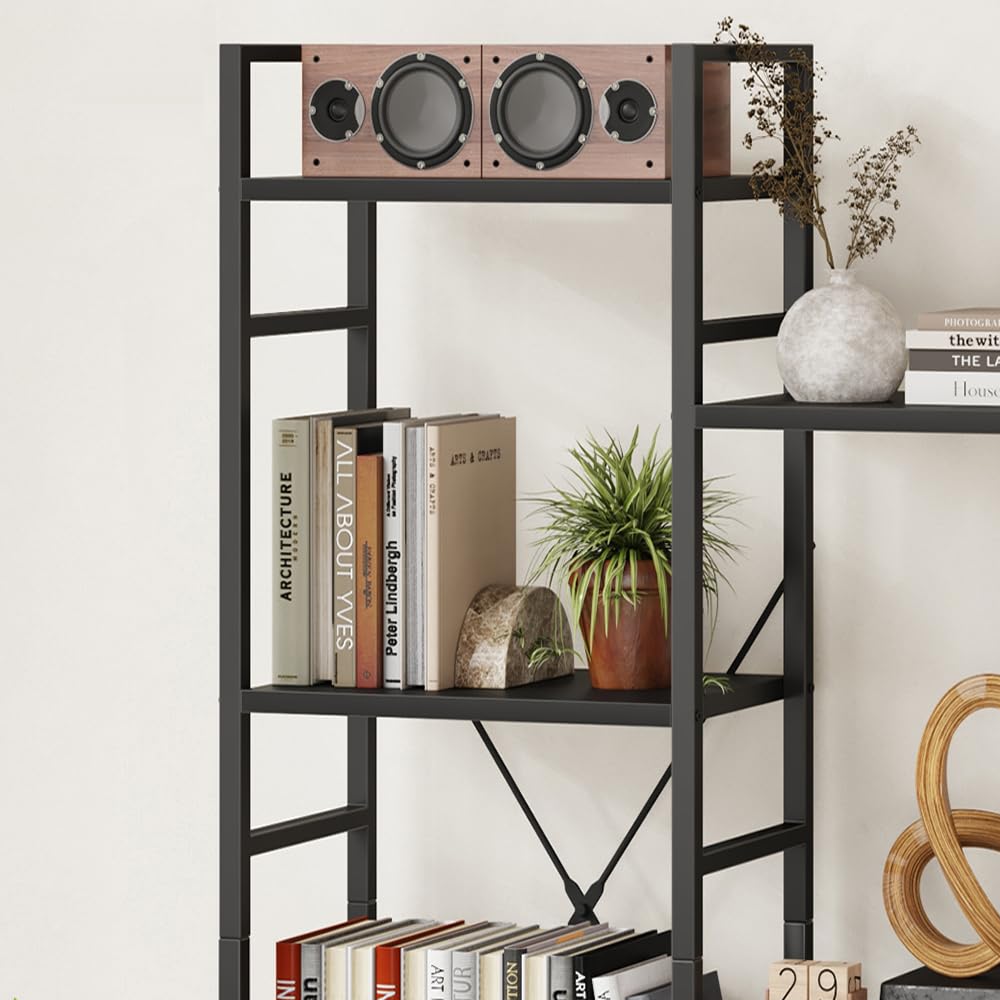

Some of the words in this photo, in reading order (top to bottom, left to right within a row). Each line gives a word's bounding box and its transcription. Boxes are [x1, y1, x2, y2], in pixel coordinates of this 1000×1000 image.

[949, 334, 976, 347] the
[951, 355, 981, 367] THE
[335, 439, 354, 485] ALL
[450, 453, 467, 466] ARTS
[280, 471, 292, 602] ARCHITECTURE
[335, 495, 354, 580] ABOUT
[385, 540, 400, 615] Lindbergh
[335, 590, 354, 652] YVES
[385, 618, 398, 657] Peter
[430, 964, 445, 993] ART
[575, 970, 587, 999] ART
